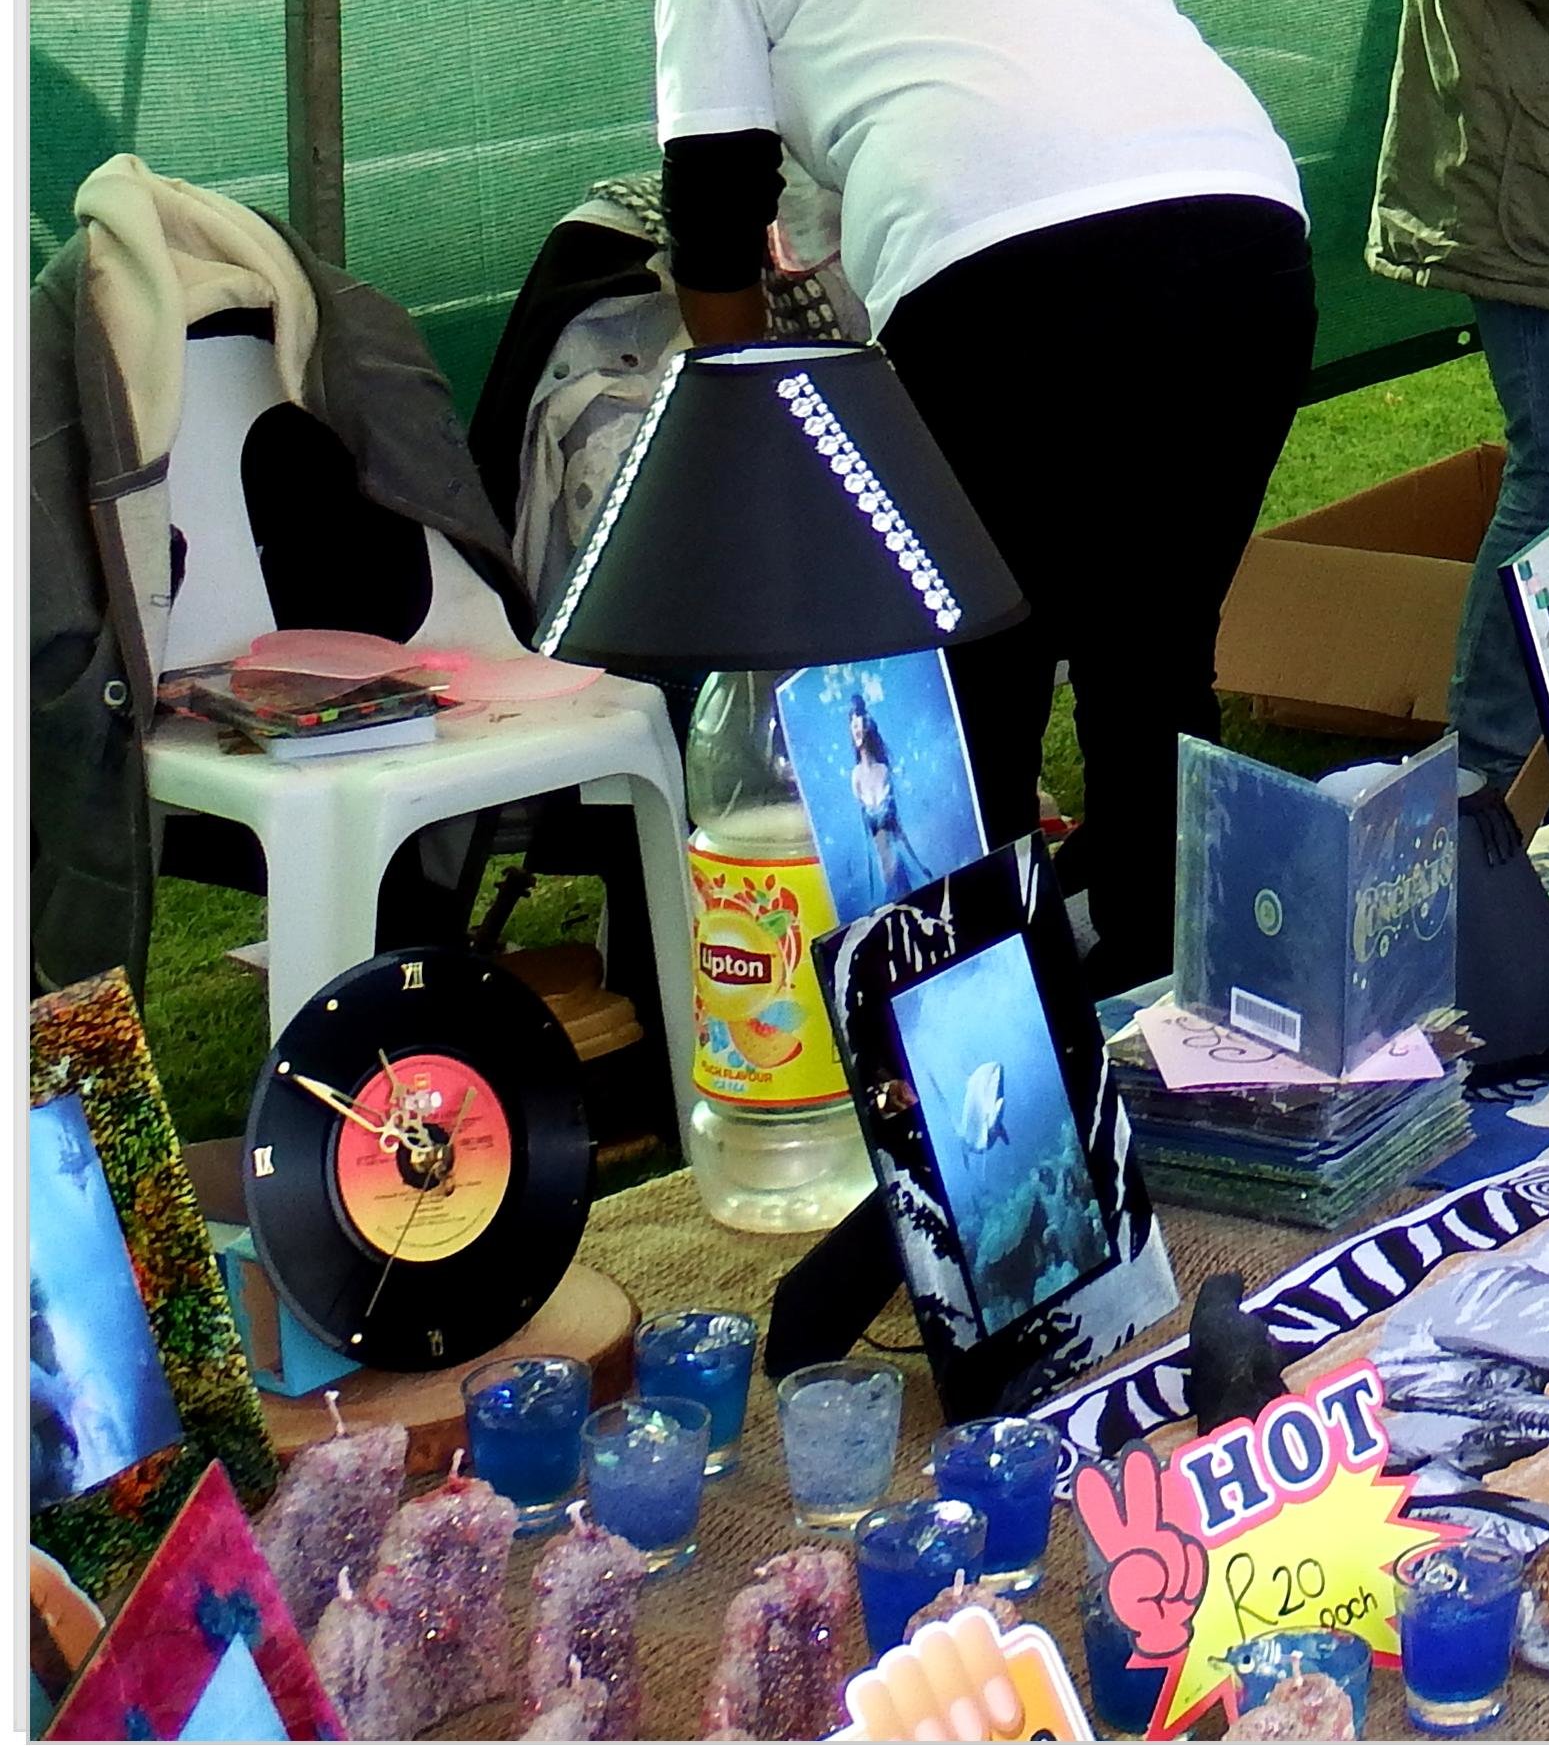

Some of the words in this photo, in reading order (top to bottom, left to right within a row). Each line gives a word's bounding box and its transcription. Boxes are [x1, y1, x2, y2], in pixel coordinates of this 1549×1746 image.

[702, 947, 763, 979] Lipton
[1187, 1377, 1379, 1531] HOT
[1225, 1552, 1327, 1643] R20
